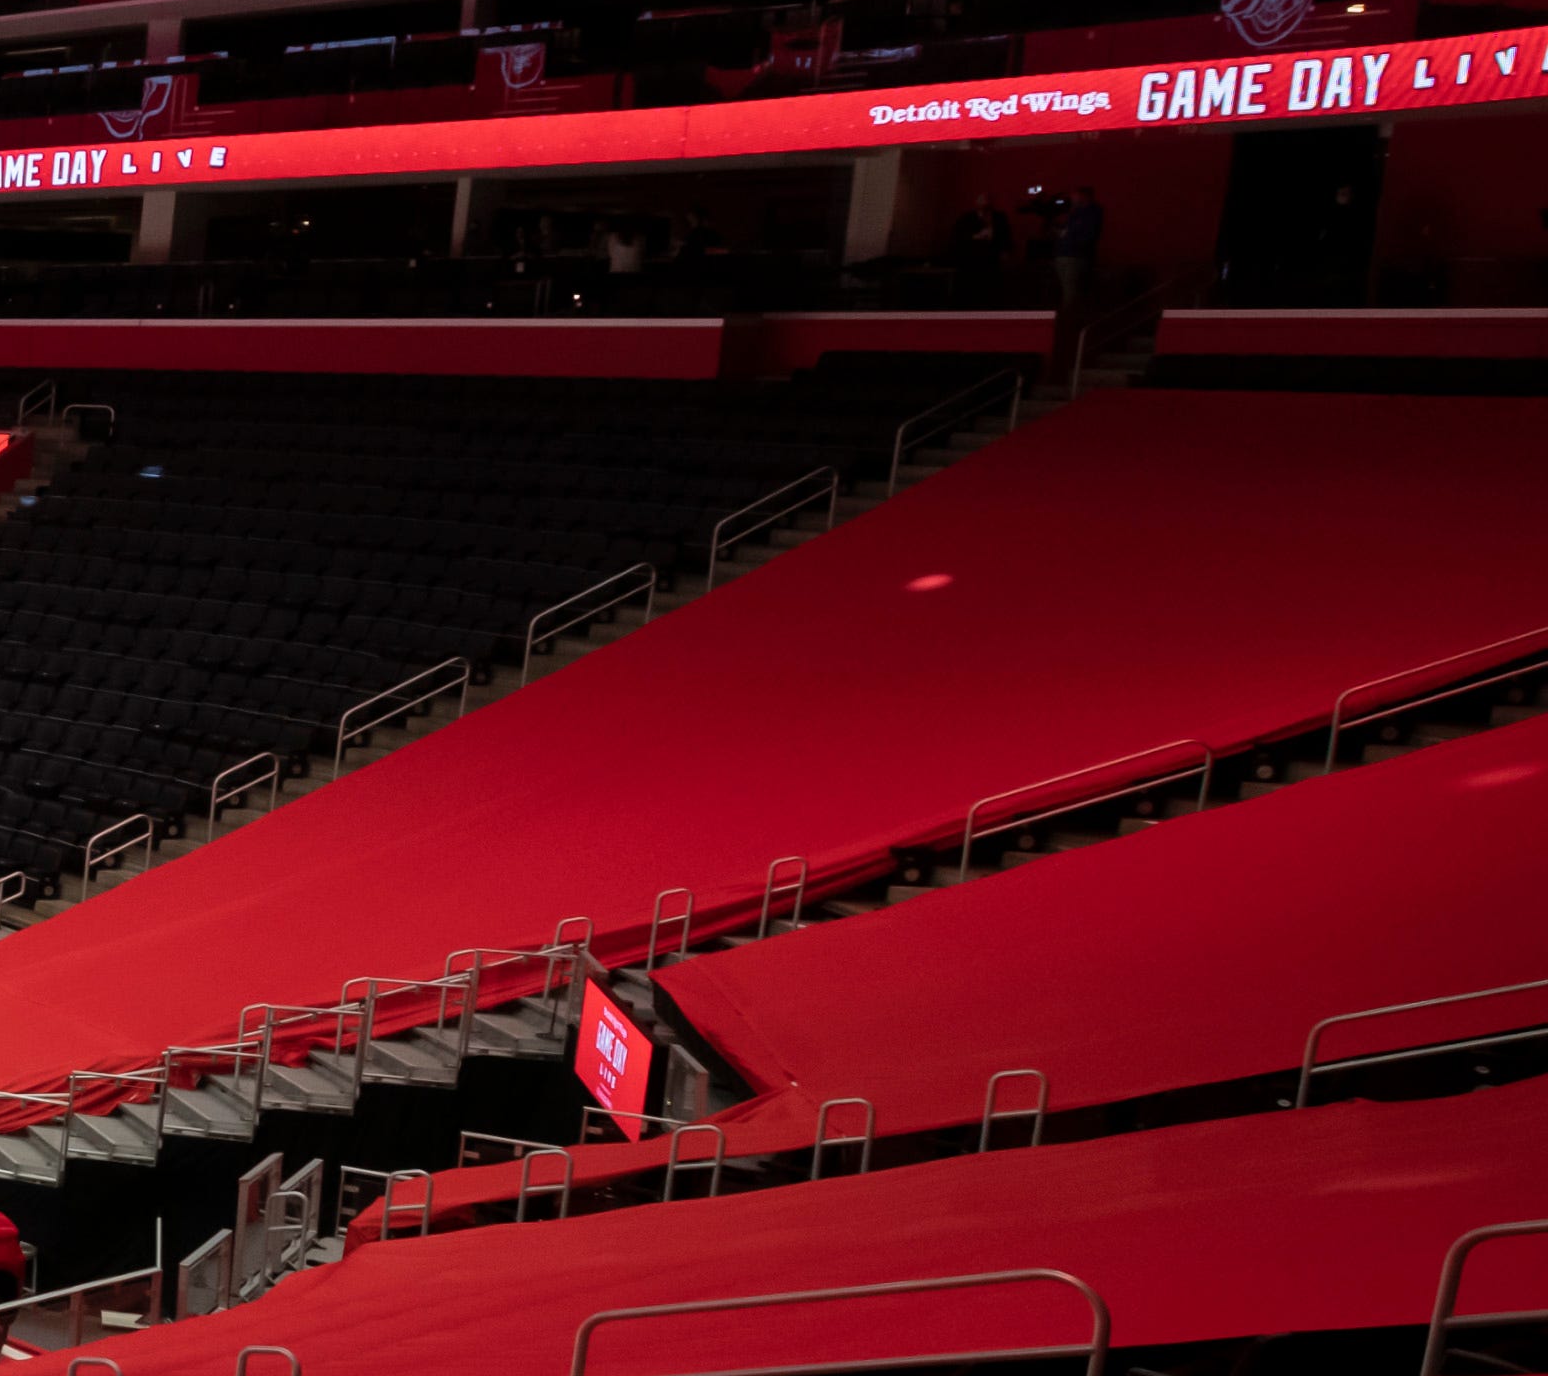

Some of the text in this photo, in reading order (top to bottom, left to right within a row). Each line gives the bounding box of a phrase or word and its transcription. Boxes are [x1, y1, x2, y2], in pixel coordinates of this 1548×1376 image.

[869, 99, 961, 126] Detroit
[964, 95, 1018, 122] Red
[1019, 90, 1111, 116] Wings
[1135, 63, 1272, 121] GAME
[1286, 52, 1390, 111] DAY
[51, 149, 107, 185] DAY
[122, 147, 227, 174] LIVE
